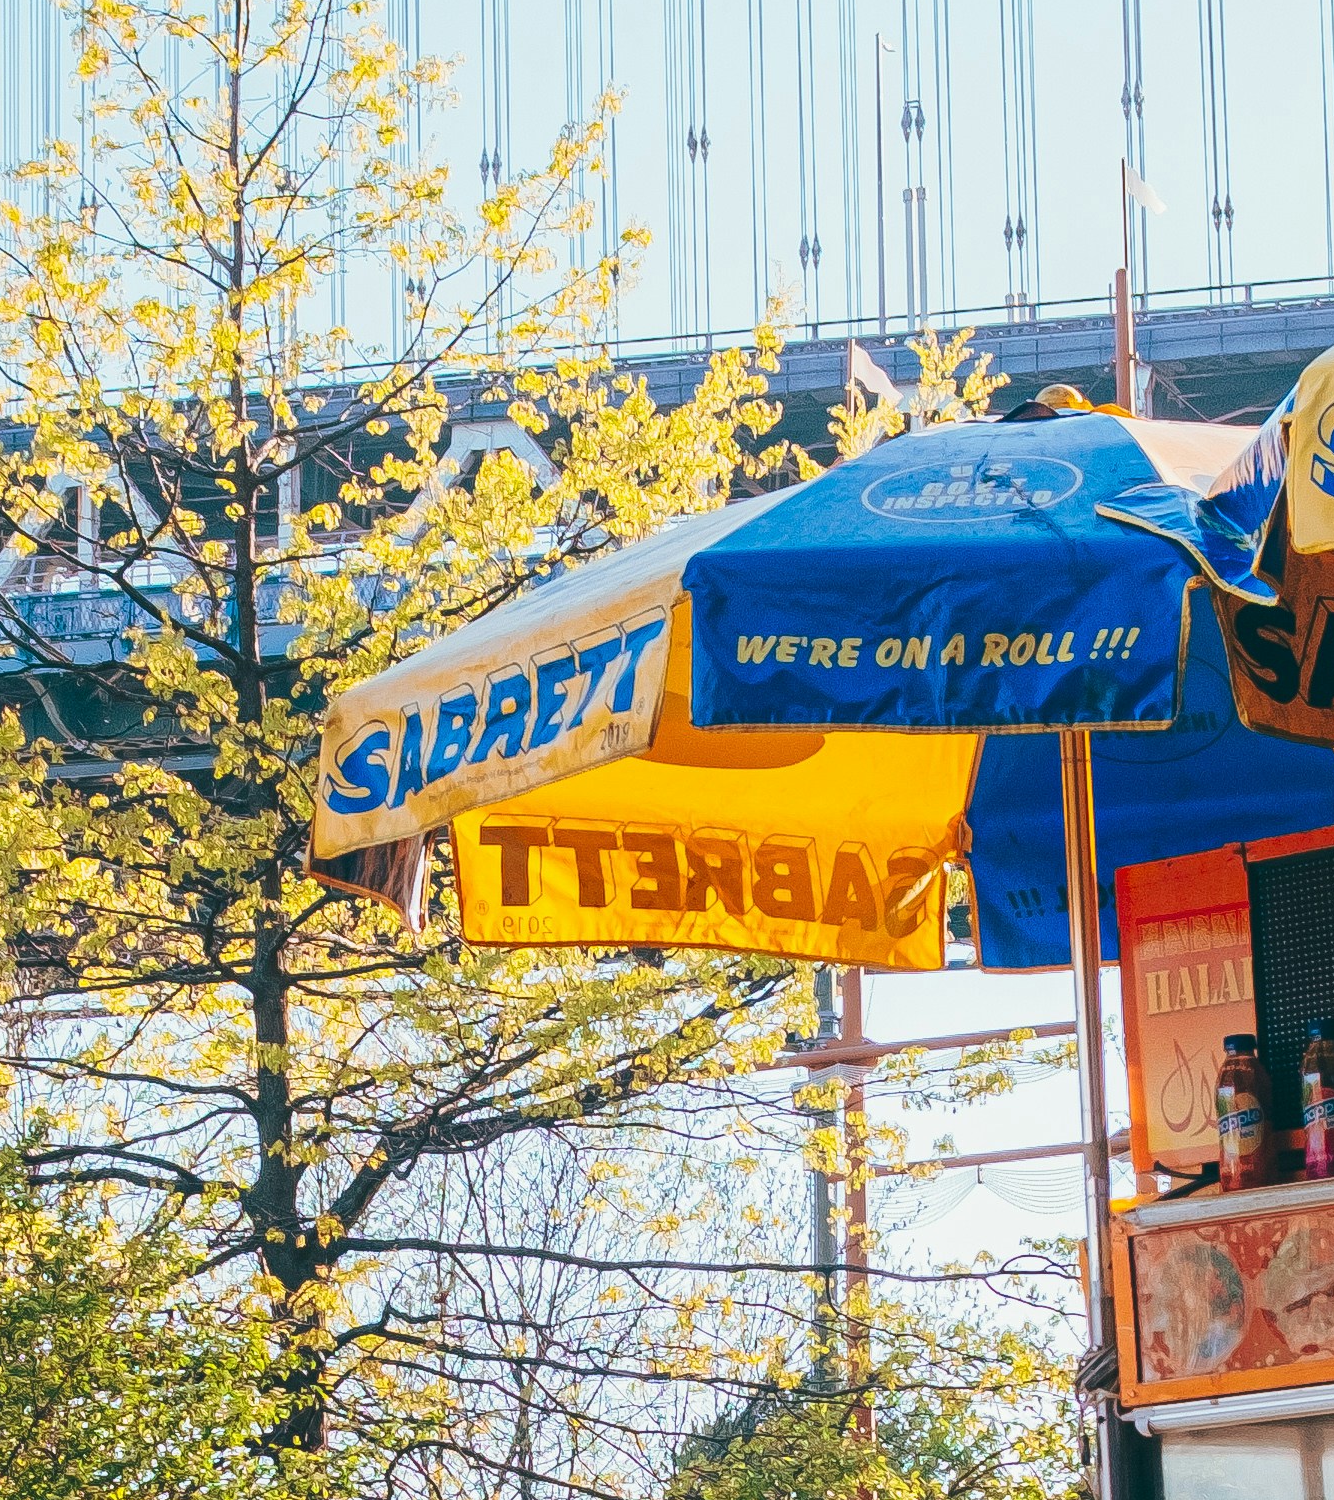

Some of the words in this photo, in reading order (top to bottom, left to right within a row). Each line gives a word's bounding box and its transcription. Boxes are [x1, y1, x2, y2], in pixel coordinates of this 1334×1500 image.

[881, 490, 1053, 510] INSPECTED
[736, 634, 863, 669] WE'RE
[876, 634, 932, 670] ON
[940, 633, 966, 666] A
[982, 631, 1076, 667] ROLL
[1089, 627, 1141, 660] !!!
[321, 605, 667, 815] SABRETT
[1218, 1107, 1264, 1136] apple
